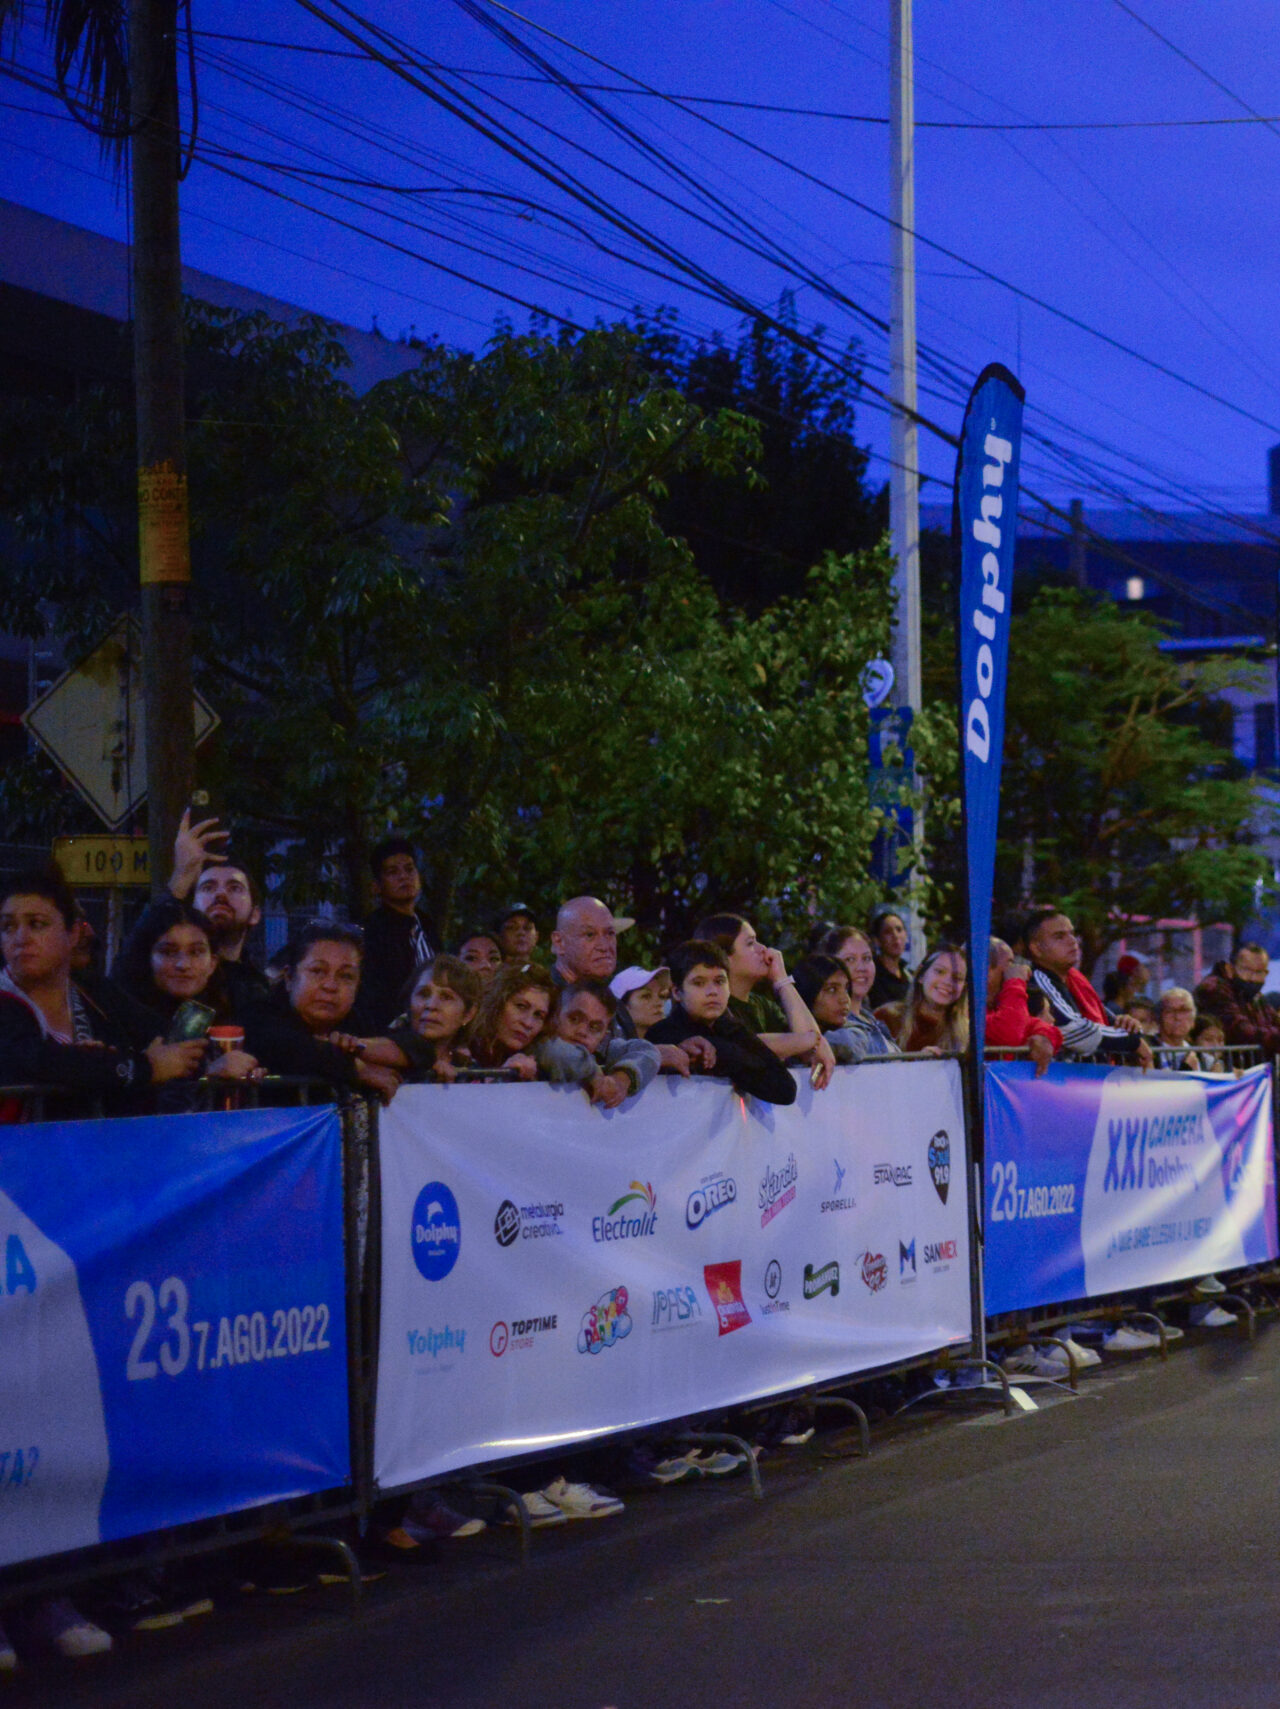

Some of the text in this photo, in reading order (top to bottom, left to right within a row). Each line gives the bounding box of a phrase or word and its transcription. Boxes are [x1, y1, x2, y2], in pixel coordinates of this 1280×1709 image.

[966, 432, 1013, 763] Dolphy
[84, 850, 123, 873] 100
[1103, 1116, 1148, 1193] XXI
[686, 1178, 737, 1230] OREO
[991, 1161, 1018, 1222] 23
[416, 1224, 459, 1247] Dolphy
[592, 1211, 658, 1243] Electrolit
[923, 1240, 958, 1265] SANMEX
[124, 1277, 330, 1381] 23 7.AGO.2022
[407, 1325, 467, 1357] Yolphy
[511, 1315, 557, 1336] TOPTIME
